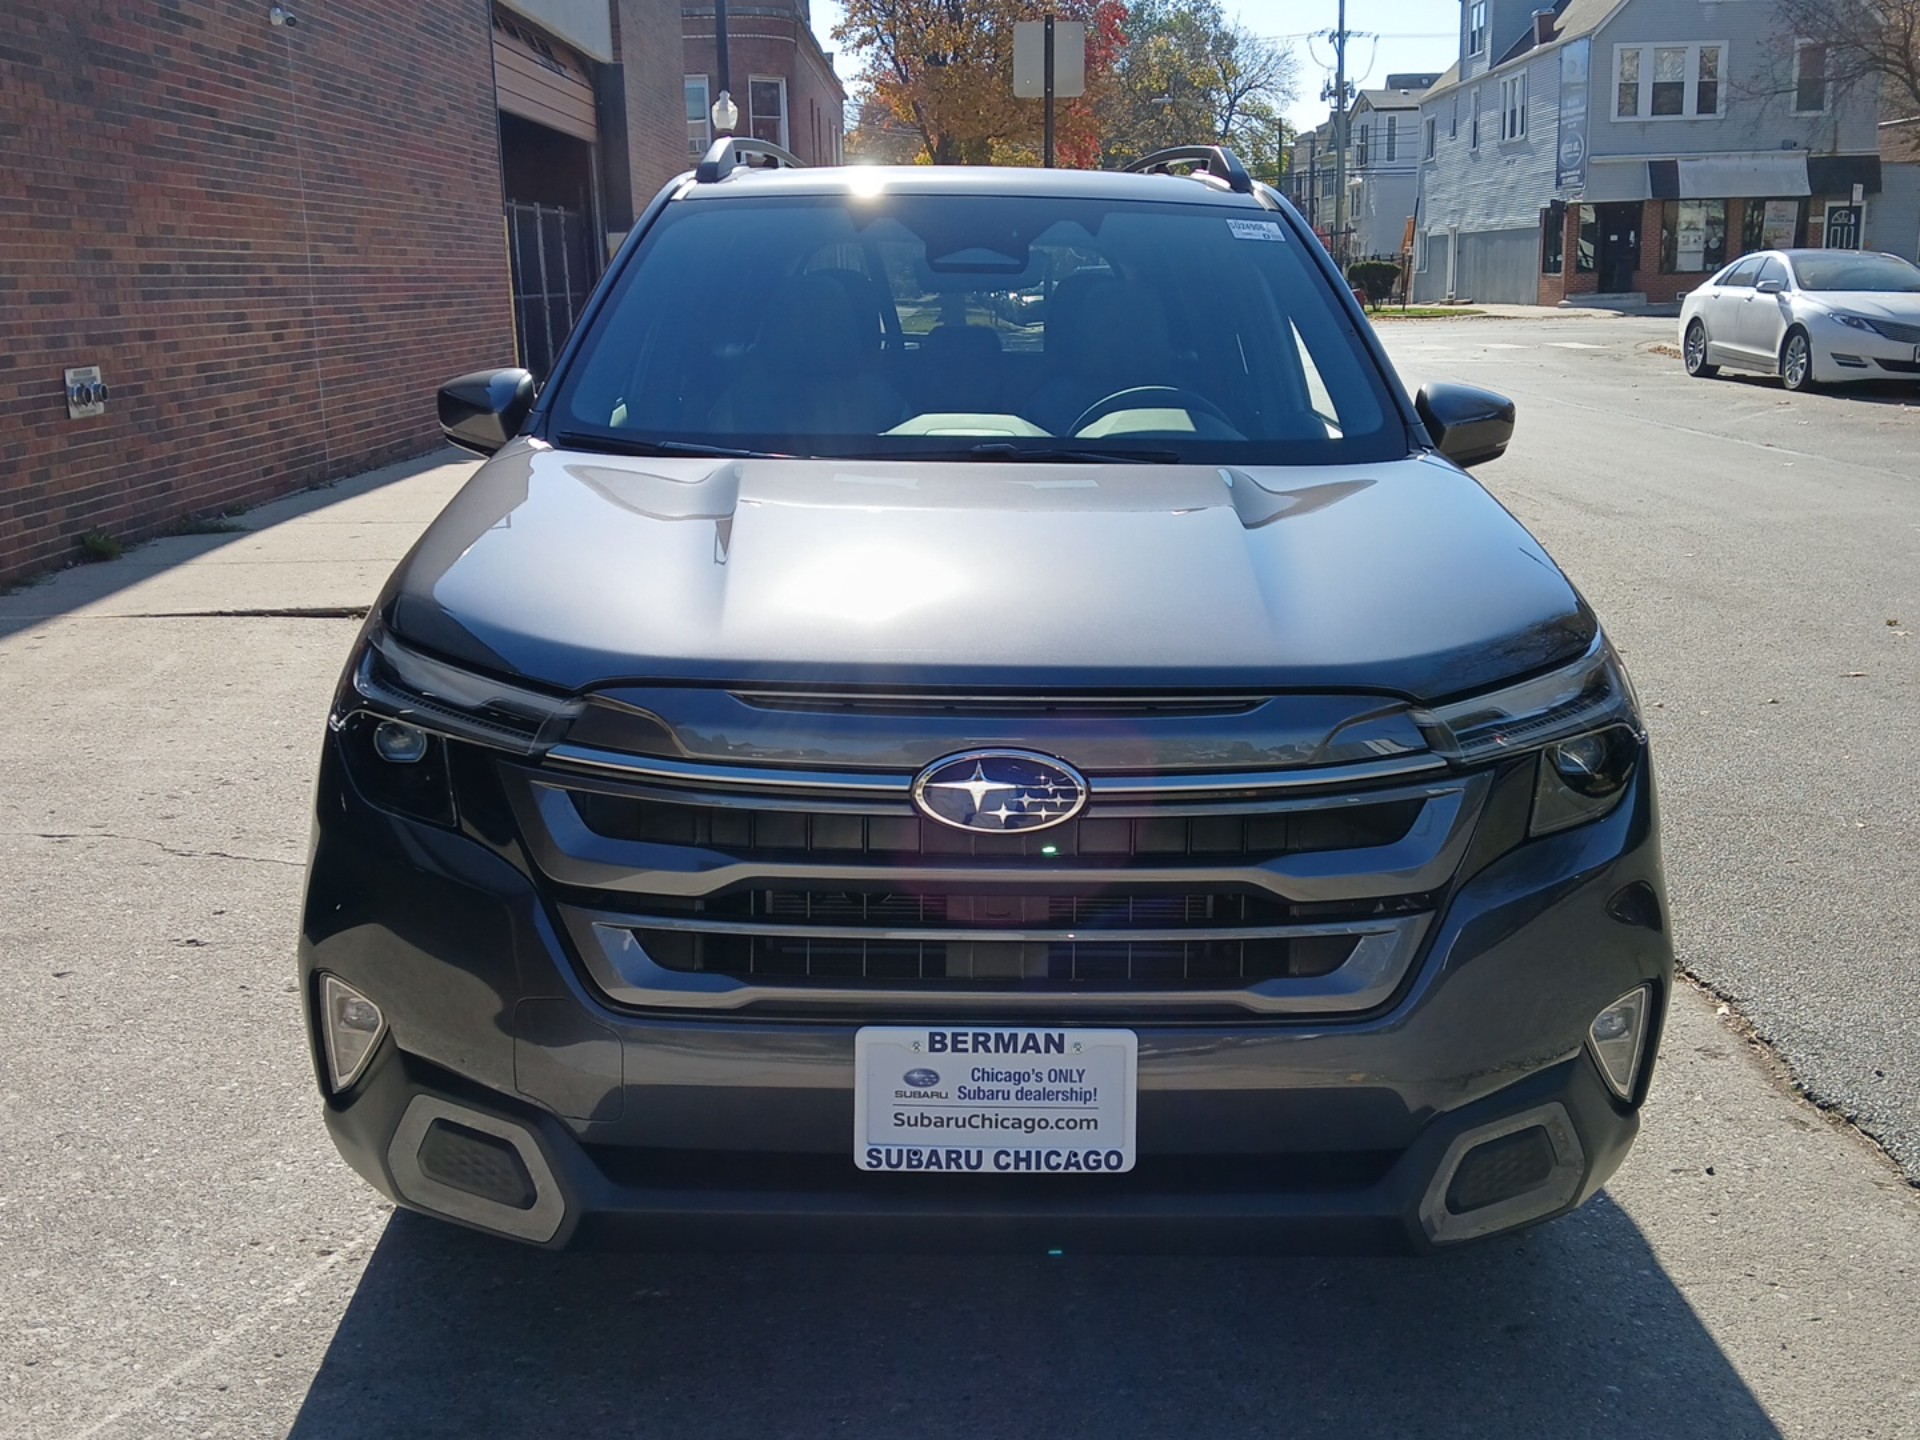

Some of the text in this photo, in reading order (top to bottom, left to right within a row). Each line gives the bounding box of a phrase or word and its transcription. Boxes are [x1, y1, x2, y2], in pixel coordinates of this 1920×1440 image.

[928, 1032, 1065, 1055] BERMAN
[971, 1067, 1086, 1086] Chicago's ONLY
[894, 1090, 949, 1100] SUBARU
[957, 1085, 1098, 1105] Subaru dealership!
[893, 1112, 1099, 1134] SubaruChicago.com
[866, 1147, 1124, 1171] SUBARU CHICAGO
